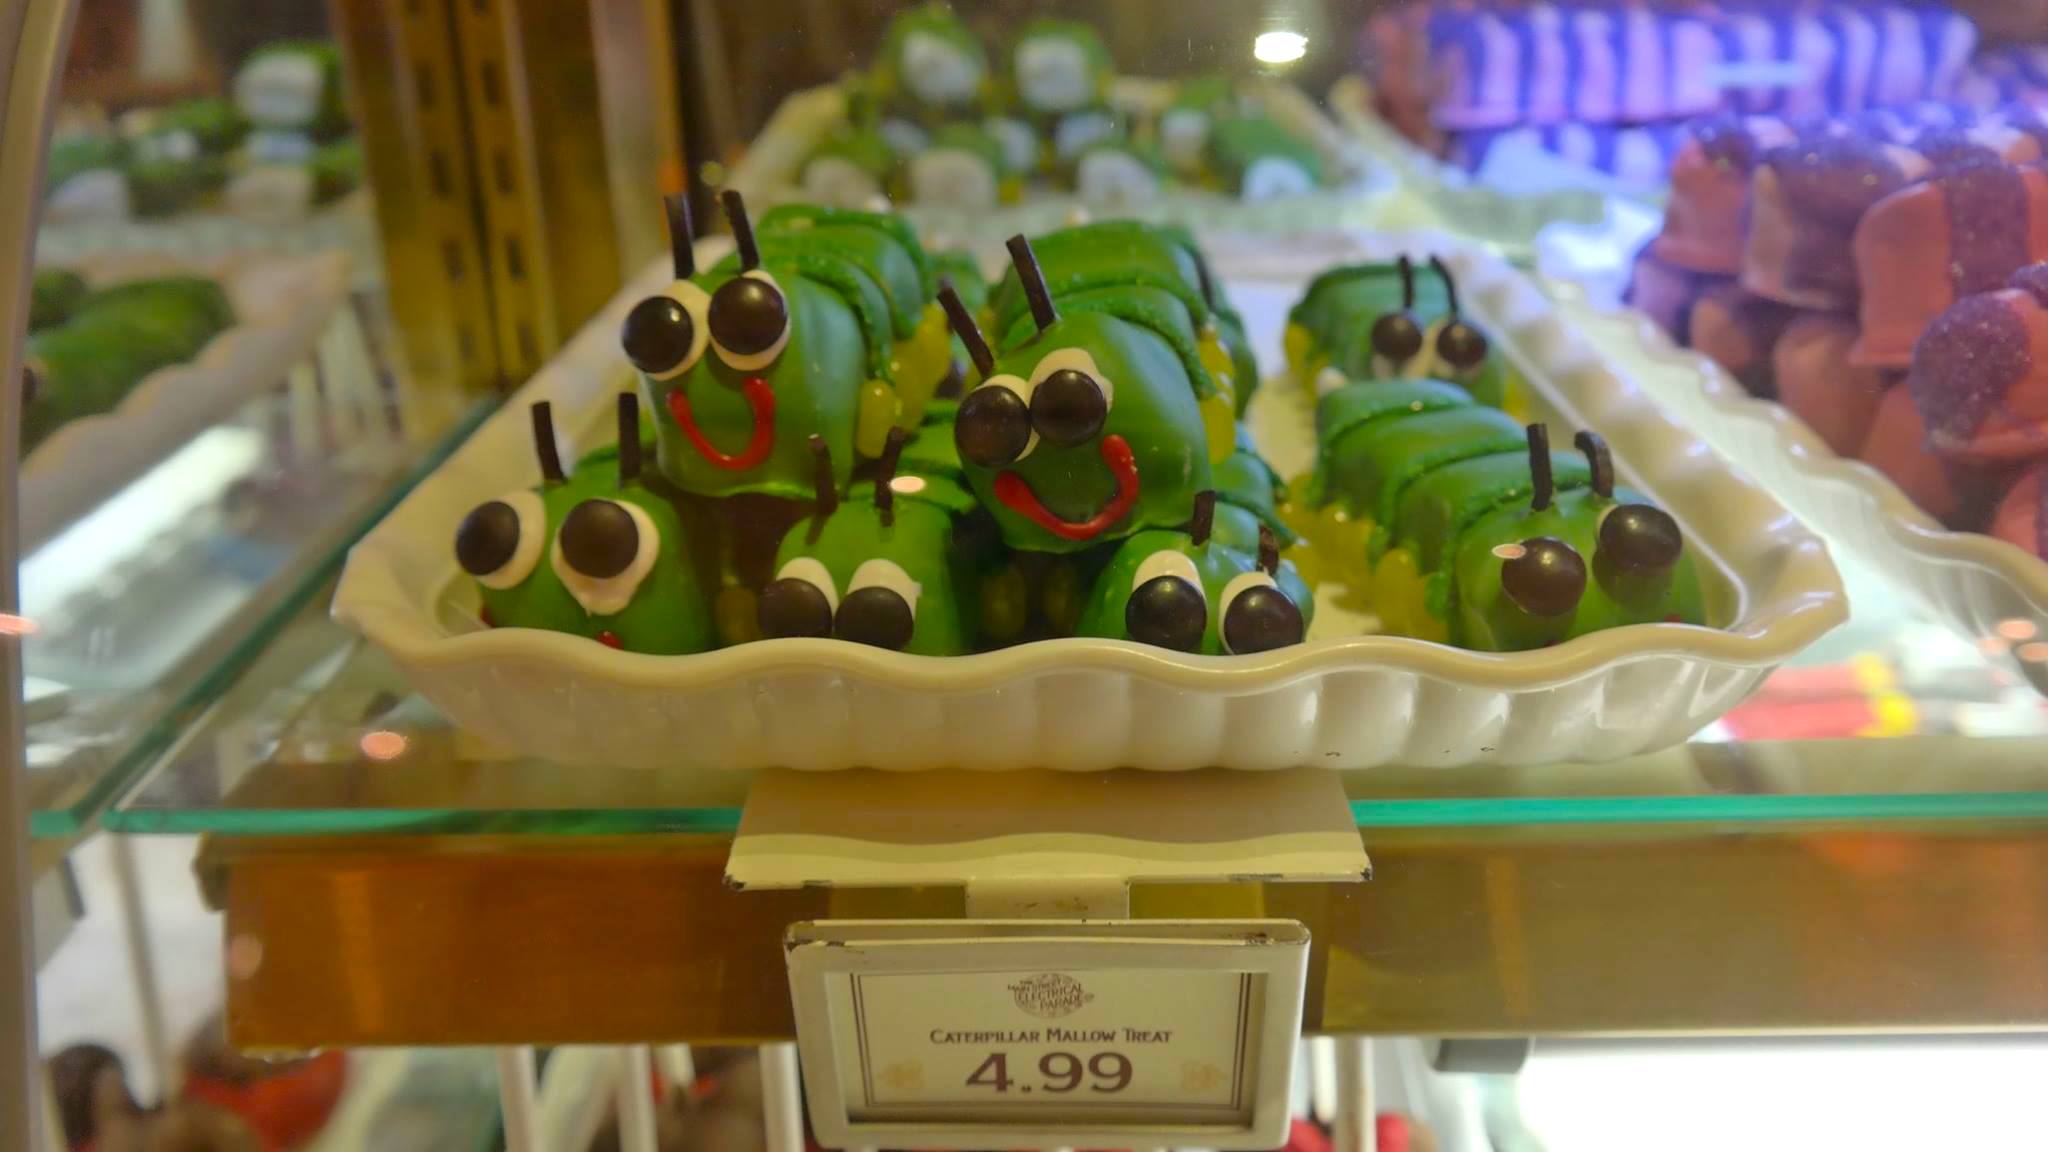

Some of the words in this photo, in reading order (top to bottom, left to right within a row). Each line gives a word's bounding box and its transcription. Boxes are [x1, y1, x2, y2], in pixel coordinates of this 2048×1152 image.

[1016, 983, 1082, 1001] ELECTRICAL
[1040, 994, 1083, 1011] PARADE
[965, 1051, 1133, 1094] 4.99
